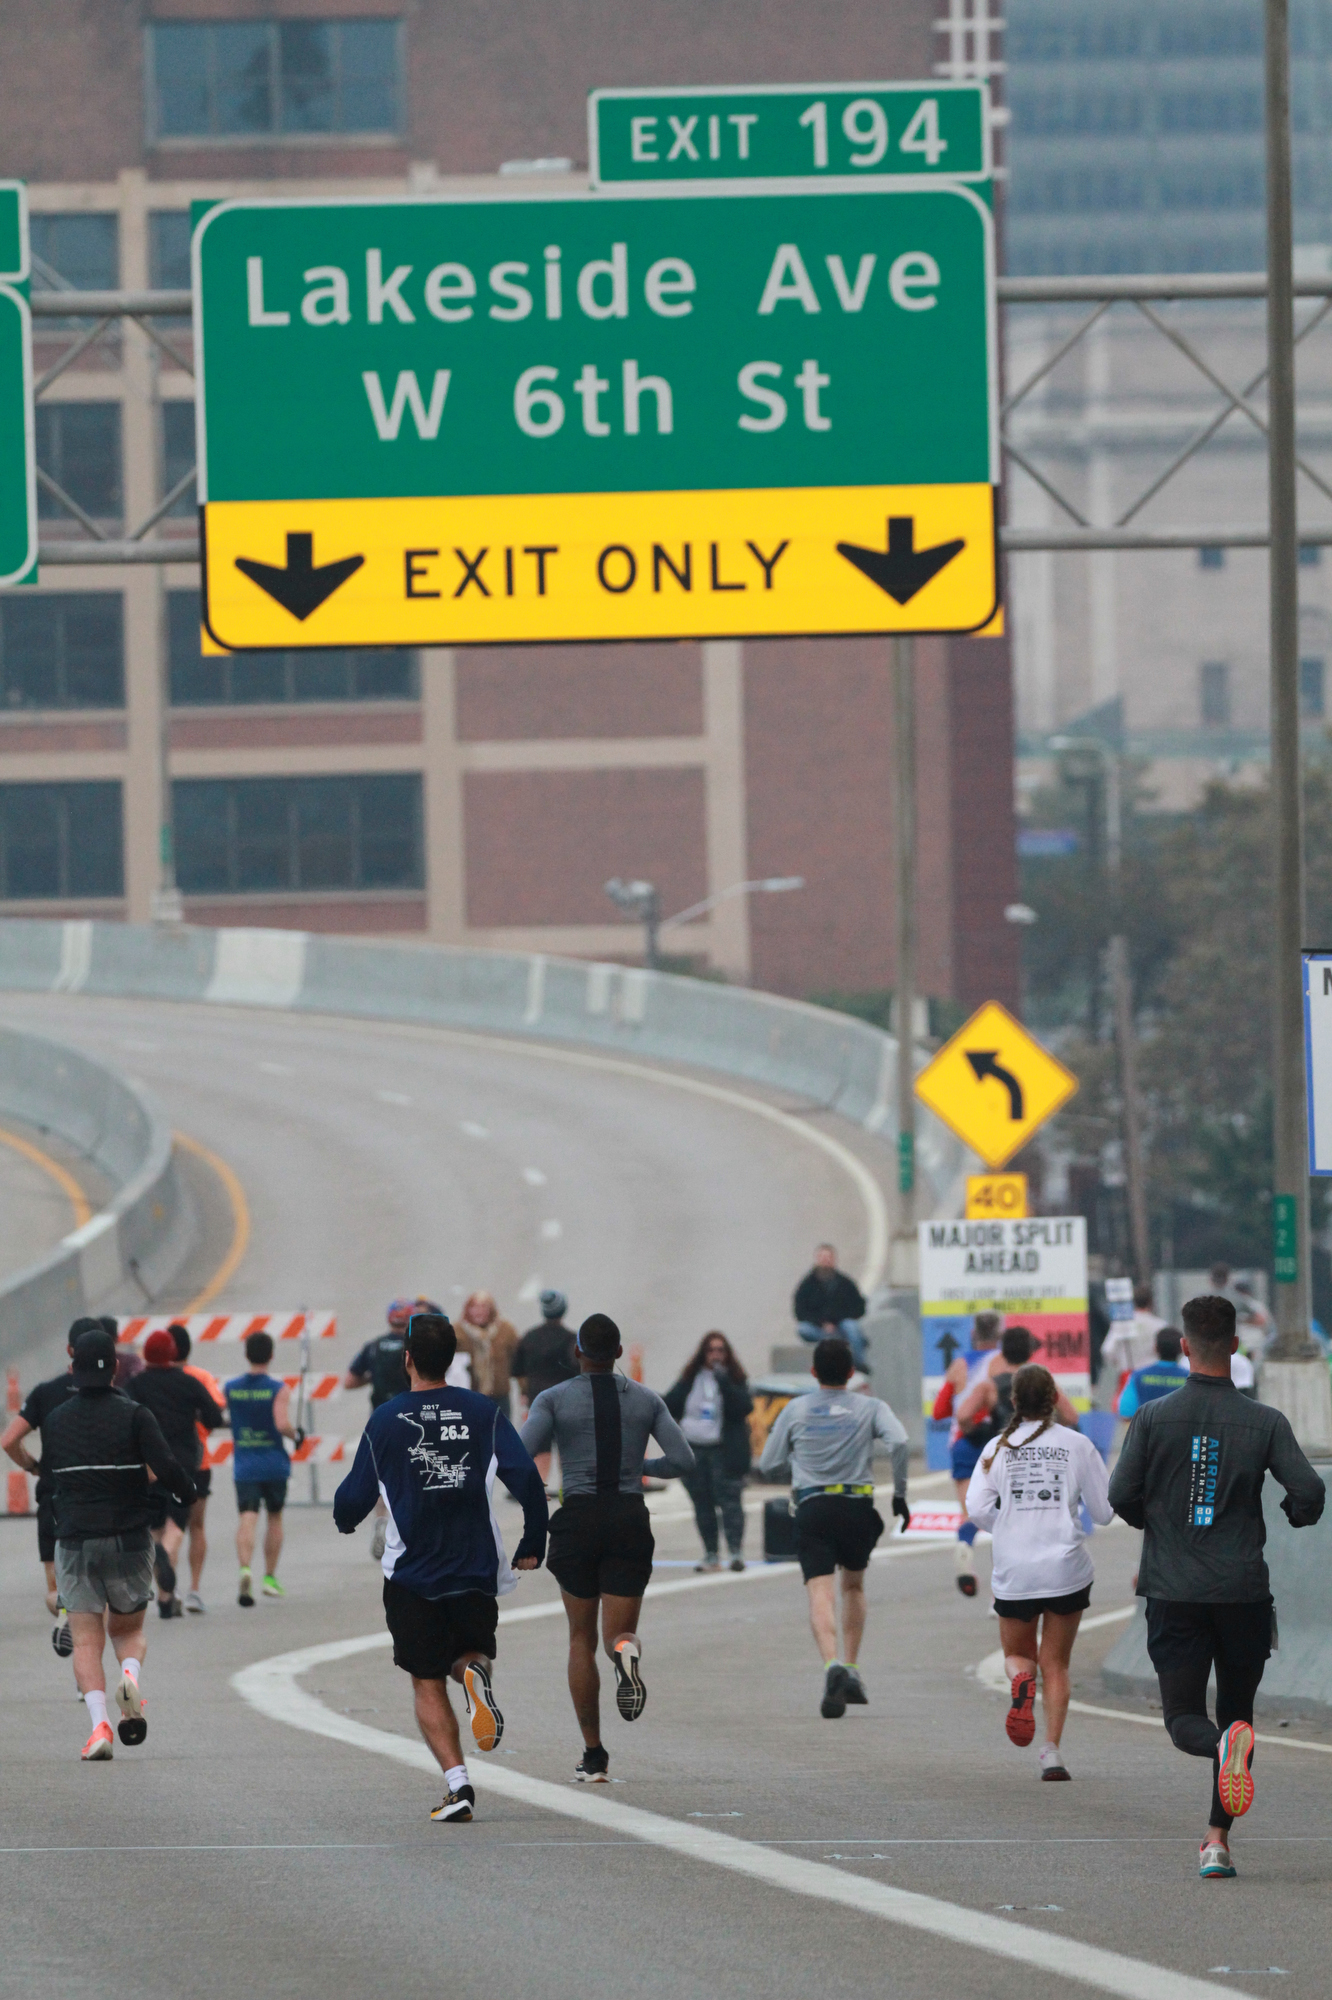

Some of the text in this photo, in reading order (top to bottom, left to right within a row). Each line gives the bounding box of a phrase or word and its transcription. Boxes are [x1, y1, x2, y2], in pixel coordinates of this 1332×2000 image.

[631, 98, 948, 168] EXIT 194
[246, 242, 941, 328] Lakeside Ave
[361, 359, 832, 442] W 6th St
[404, 539, 791, 599] EXIT ONLY
[973, 1182, 1021, 1211] 40
[929, 1222, 1074, 1247] MAJOR SPLIT
[966, 1250, 1040, 1273] AHEAD
[440, 1424, 469, 1440] 26.2
[1005, 1446, 1069, 1463] CONCRETE SNEAKERZ
[1197, 1435, 1207, 1503] MARATHON
[1204, 1437, 1220, 1503] AKRON
